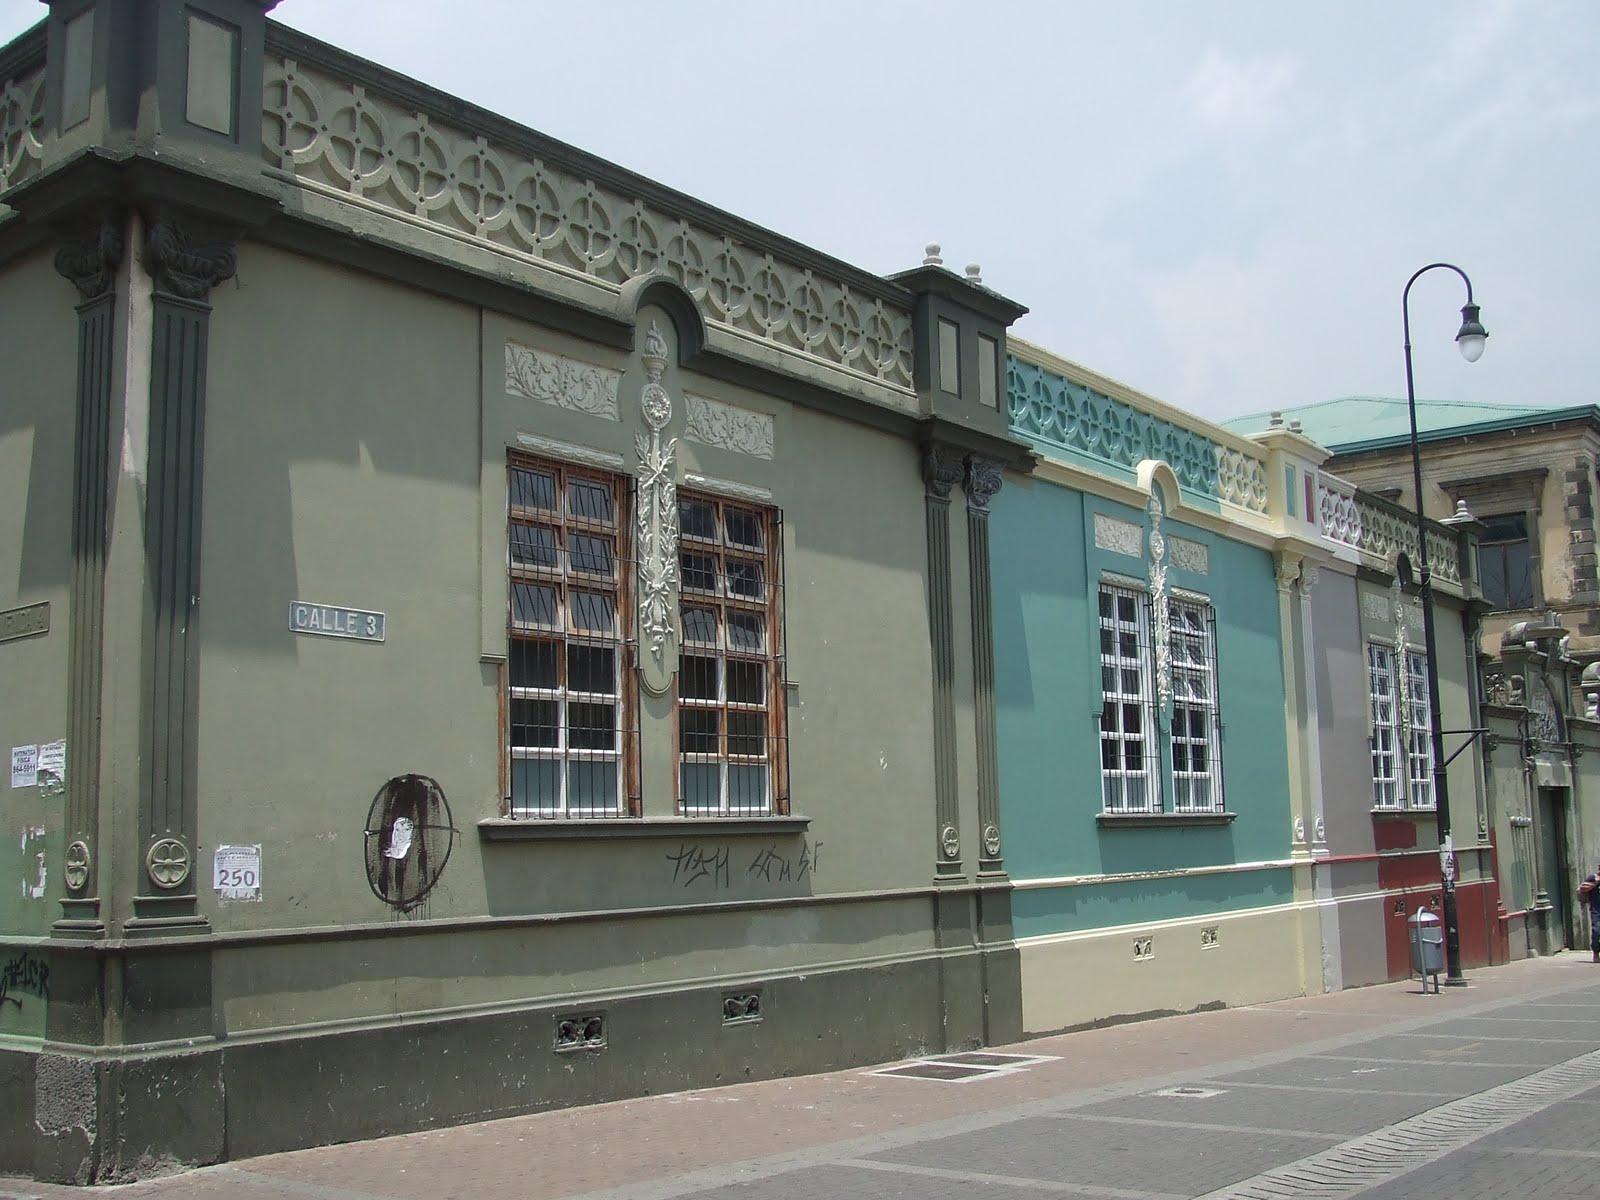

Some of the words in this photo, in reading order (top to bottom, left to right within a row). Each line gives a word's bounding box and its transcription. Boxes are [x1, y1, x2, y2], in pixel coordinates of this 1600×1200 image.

[296, 606, 358, 633] CALLE
[366, 615, 377, 635] 3
[219, 869, 255, 887] 250
